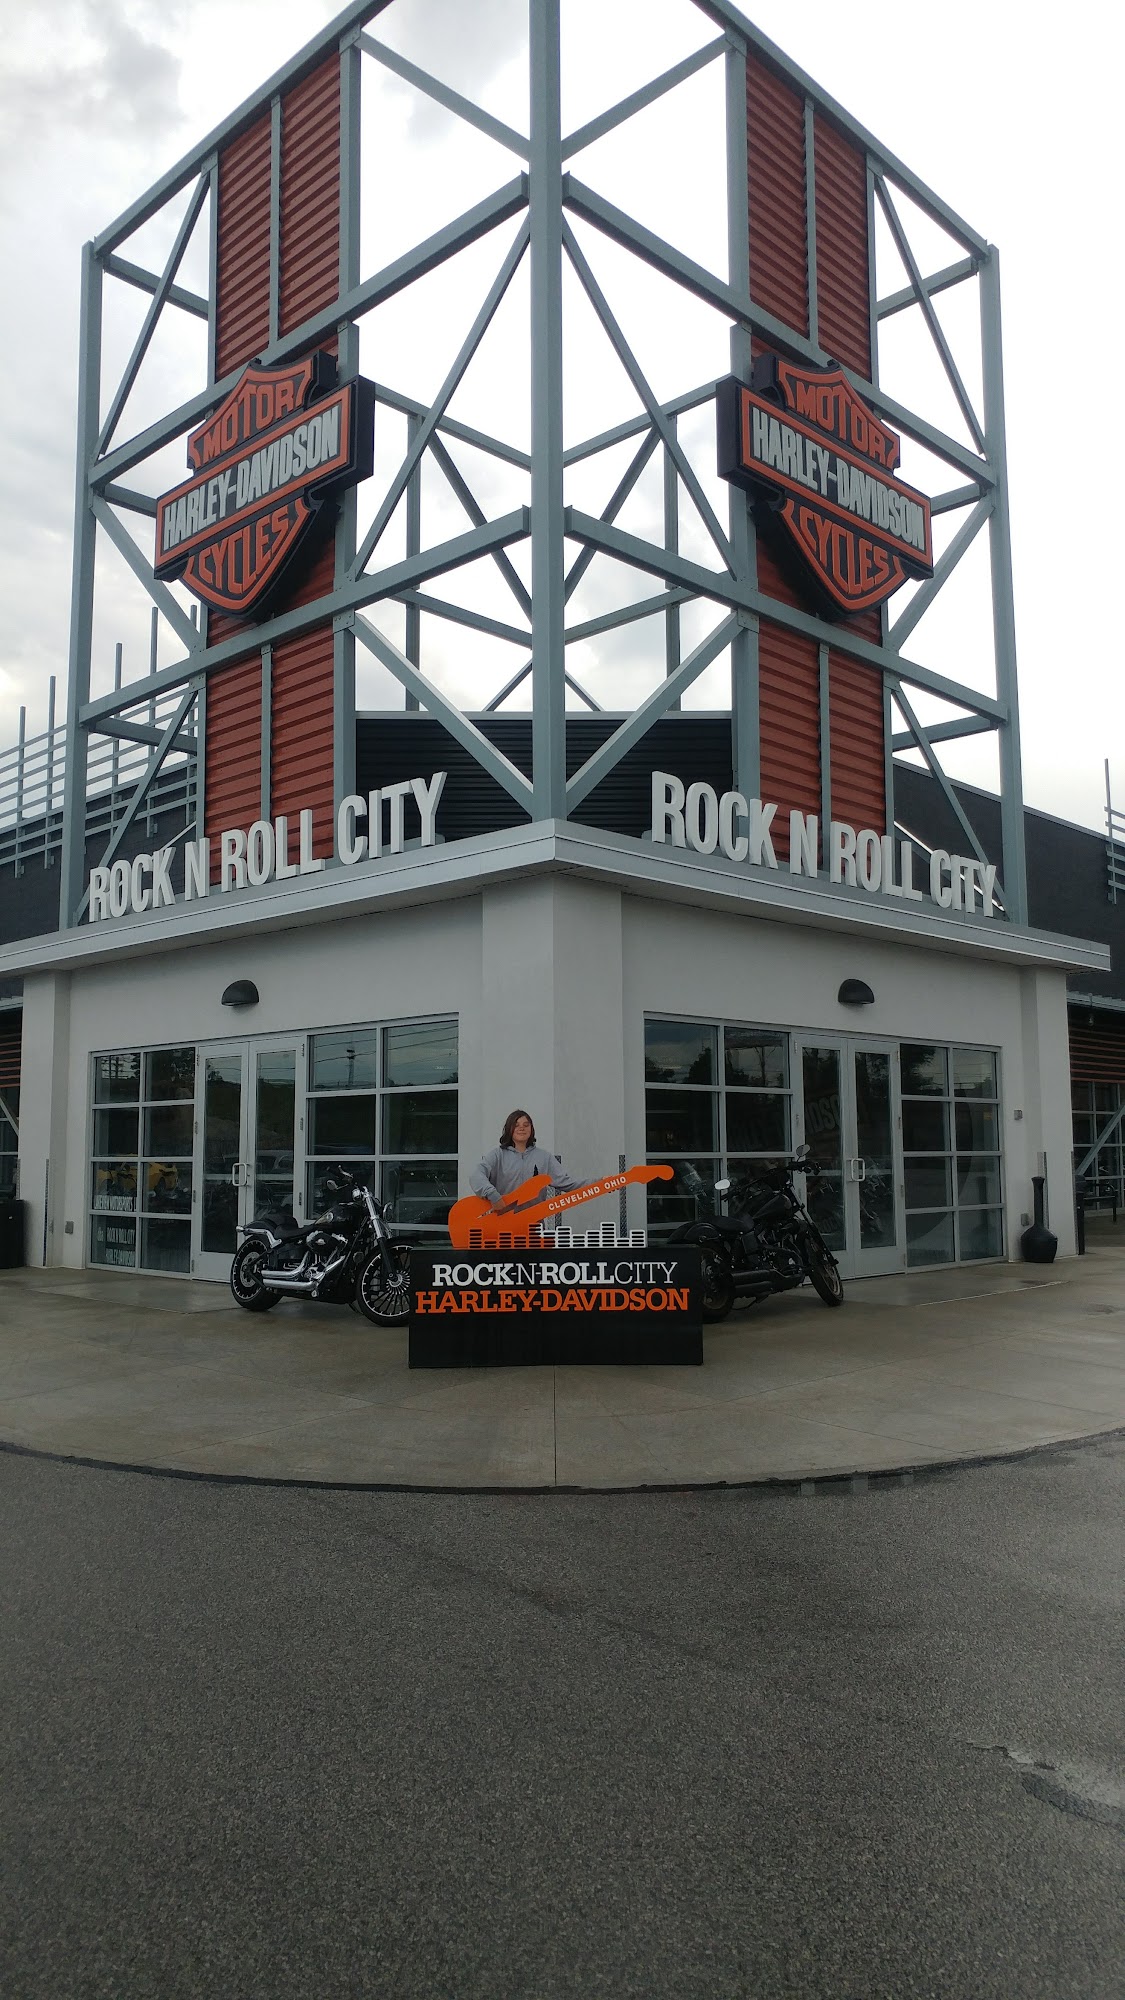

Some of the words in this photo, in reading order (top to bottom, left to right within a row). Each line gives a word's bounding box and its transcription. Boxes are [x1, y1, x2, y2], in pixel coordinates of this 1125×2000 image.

[203, 380, 295, 463] MOTOR
[796, 381, 887, 462] MOTOR
[163, 405, 340, 551] HARLEY-DAVIDSON
[752, 407, 925, 551] HARLEY-DAVIDSON
[198, 504, 290, 594] CYCLES
[800, 505, 890, 594] CYCLES
[89, 847, 176, 923] ROCK
[184, 837, 210, 901] N
[221, 809, 326, 892] ROLL
[337, 771, 447, 865] CITY
[651, 770, 778, 869] ROCK
[790, 809, 818, 878] N
[830, 820, 923, 901] ROLL
[930, 849, 997, 917] CITY
[548, 1186, 600, 1211] CLEVELAND
[604, 1176, 627, 1190] OHIO
[415, 1288, 690, 1314] HARLEY-DAVIDSON
